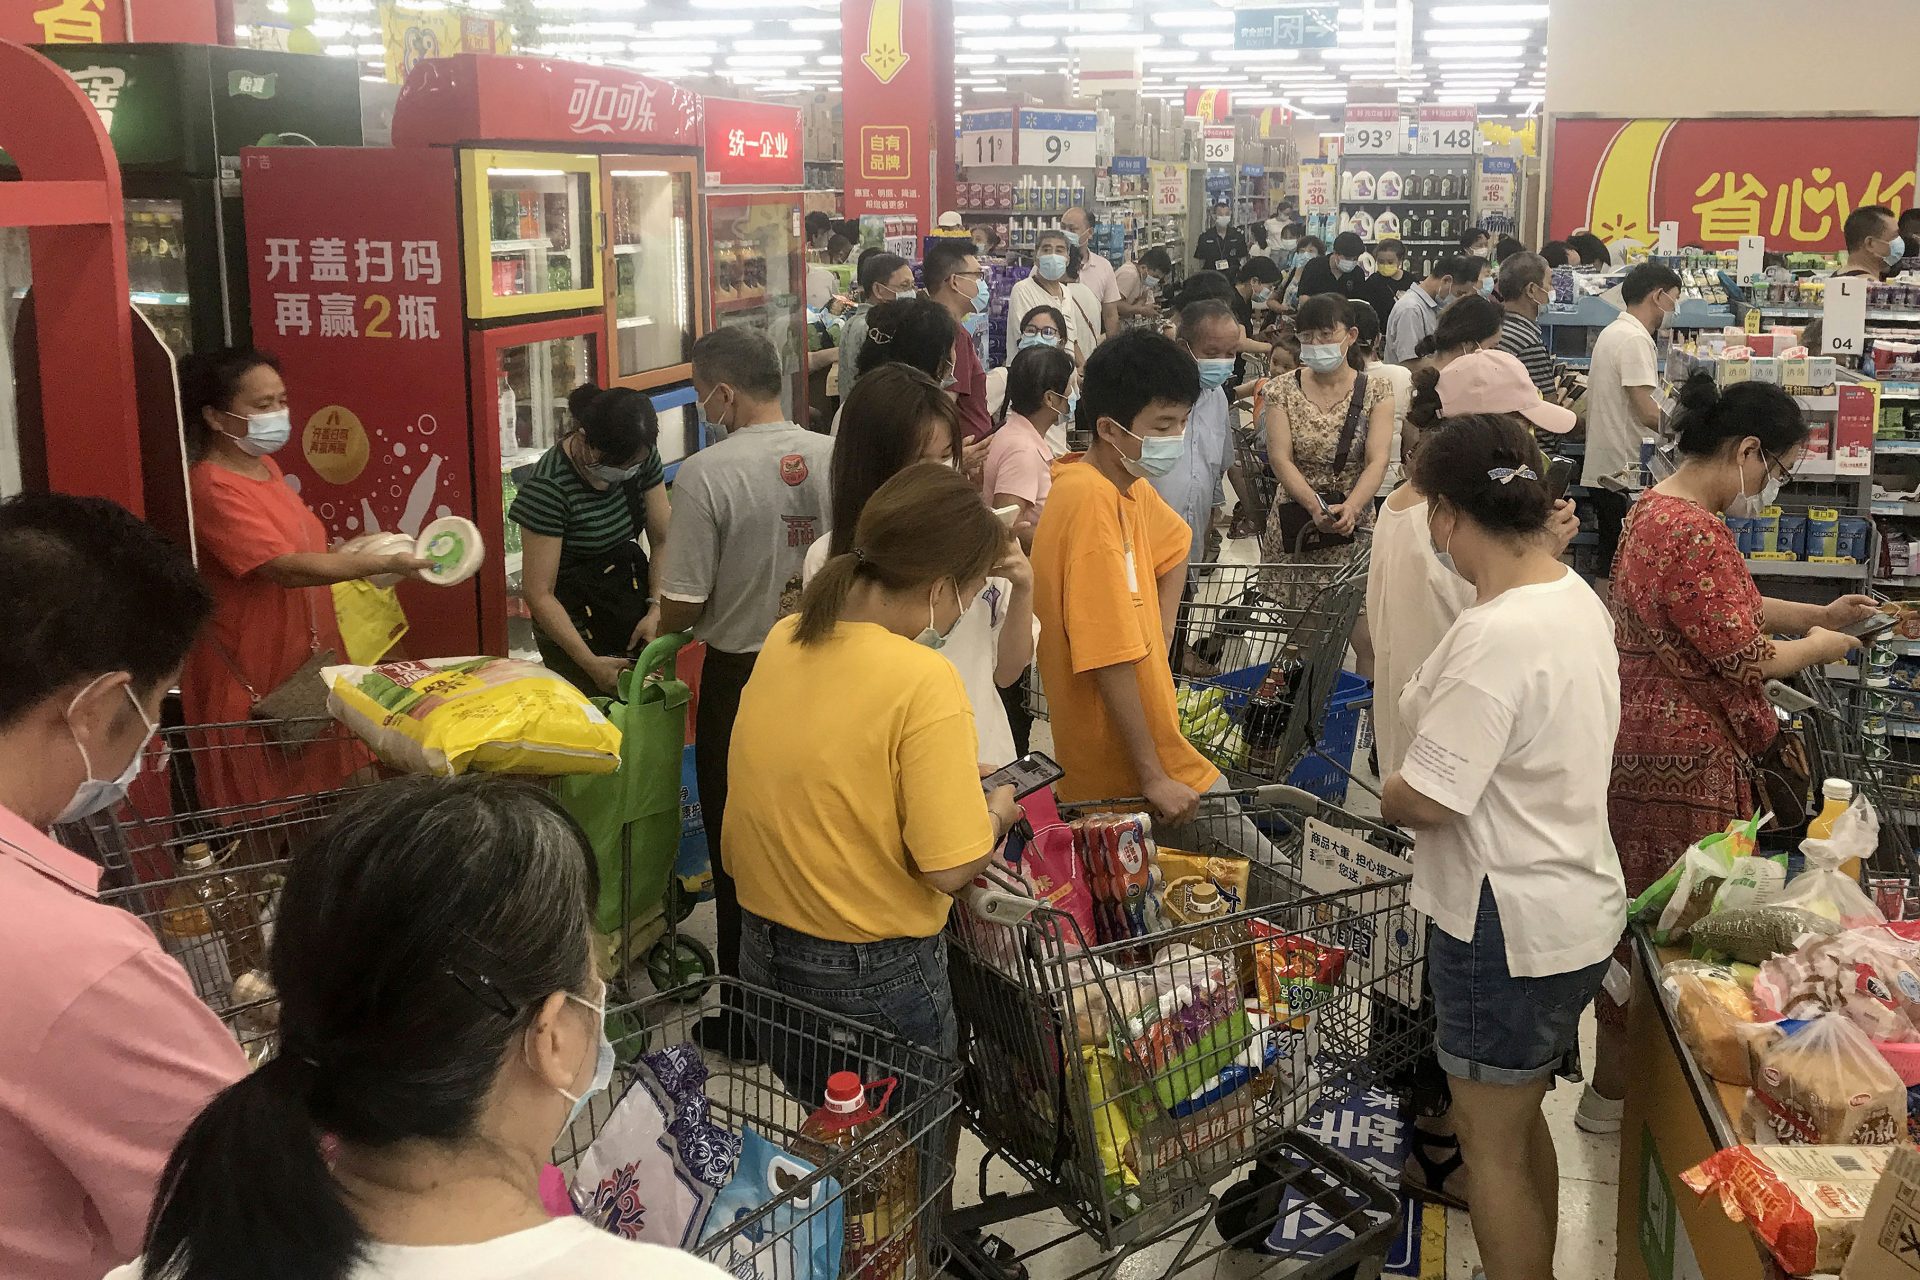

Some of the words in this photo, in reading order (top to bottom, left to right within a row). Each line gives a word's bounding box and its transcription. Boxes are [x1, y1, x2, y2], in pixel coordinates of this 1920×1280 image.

[567, 77, 658, 135] 可口可乐
[728, 128, 788, 159] 统一企业
[870, 134, 901, 152] 自有
[1432, 129, 1471, 149] 148
[870, 154, 901, 172] 品牌
[264, 237, 442, 285] 开盖扫码
[1841, 282, 1850, 297] L
[274, 292, 441, 341] 再赢2瓶
[1832, 337, 1853, 350] 04
